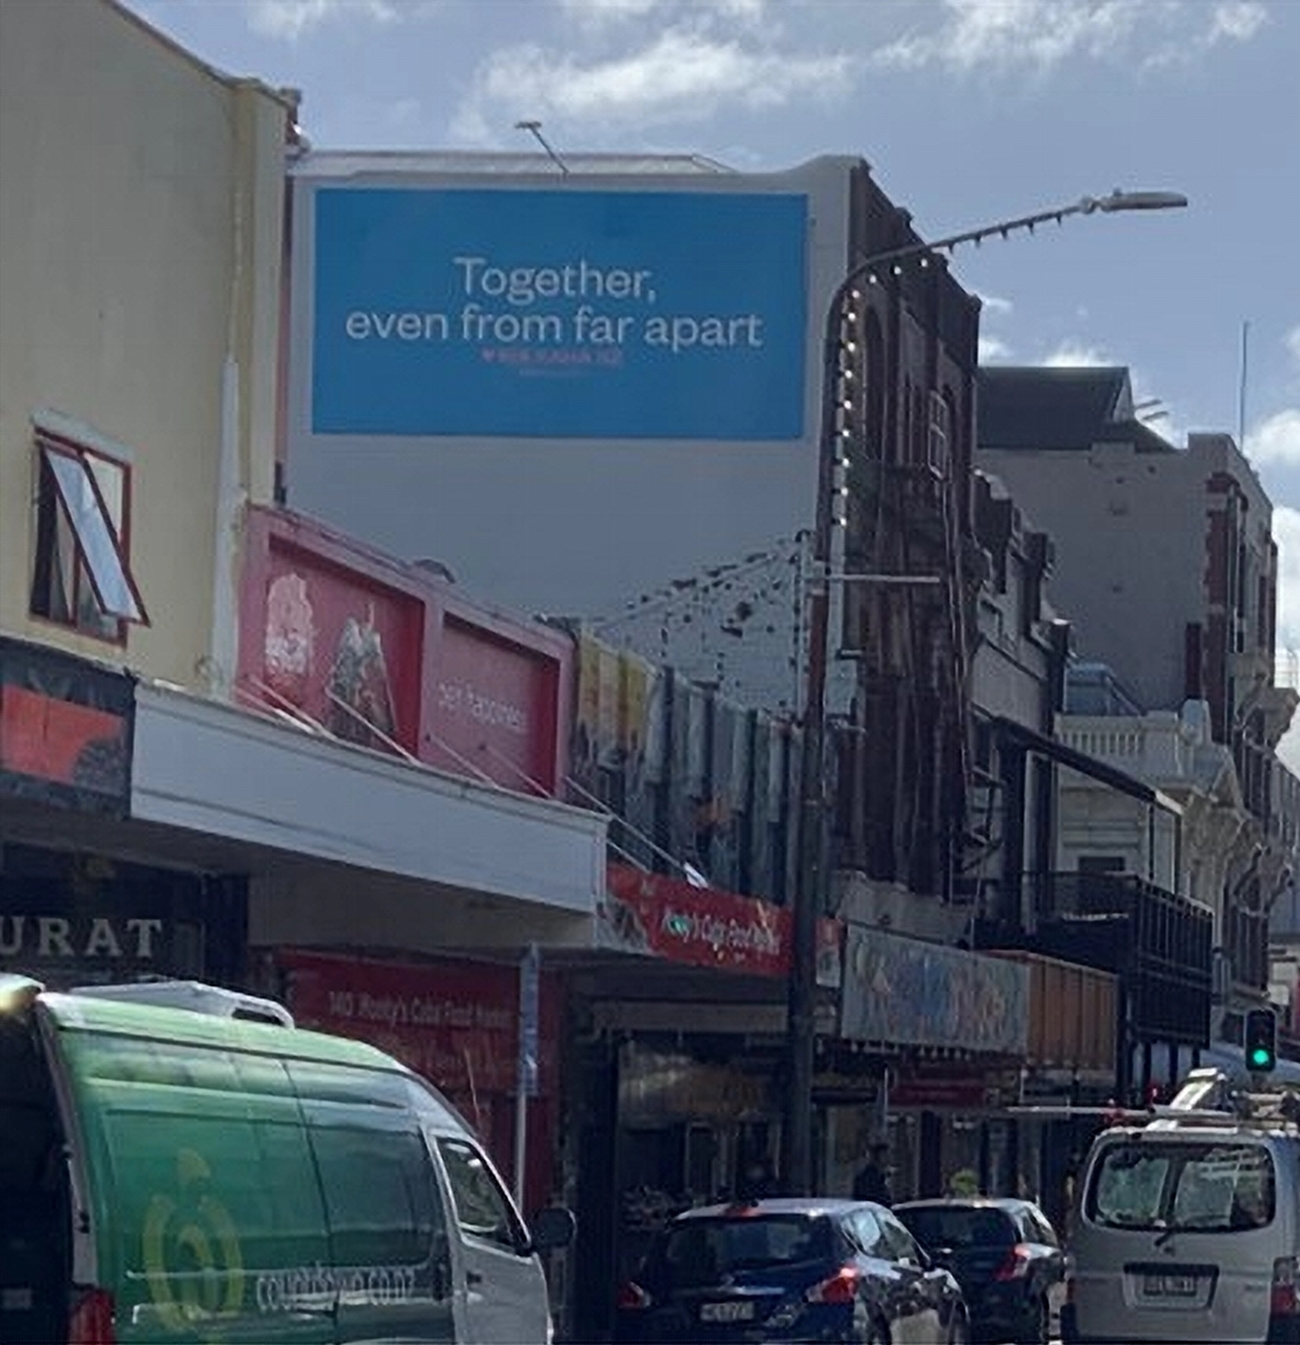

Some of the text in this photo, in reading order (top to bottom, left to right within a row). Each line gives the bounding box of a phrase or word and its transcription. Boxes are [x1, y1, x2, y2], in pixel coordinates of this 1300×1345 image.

[453, 256, 657, 306] Together,
[345, 303, 764, 354] even from far apart
[0, 915, 162, 958] URAT
